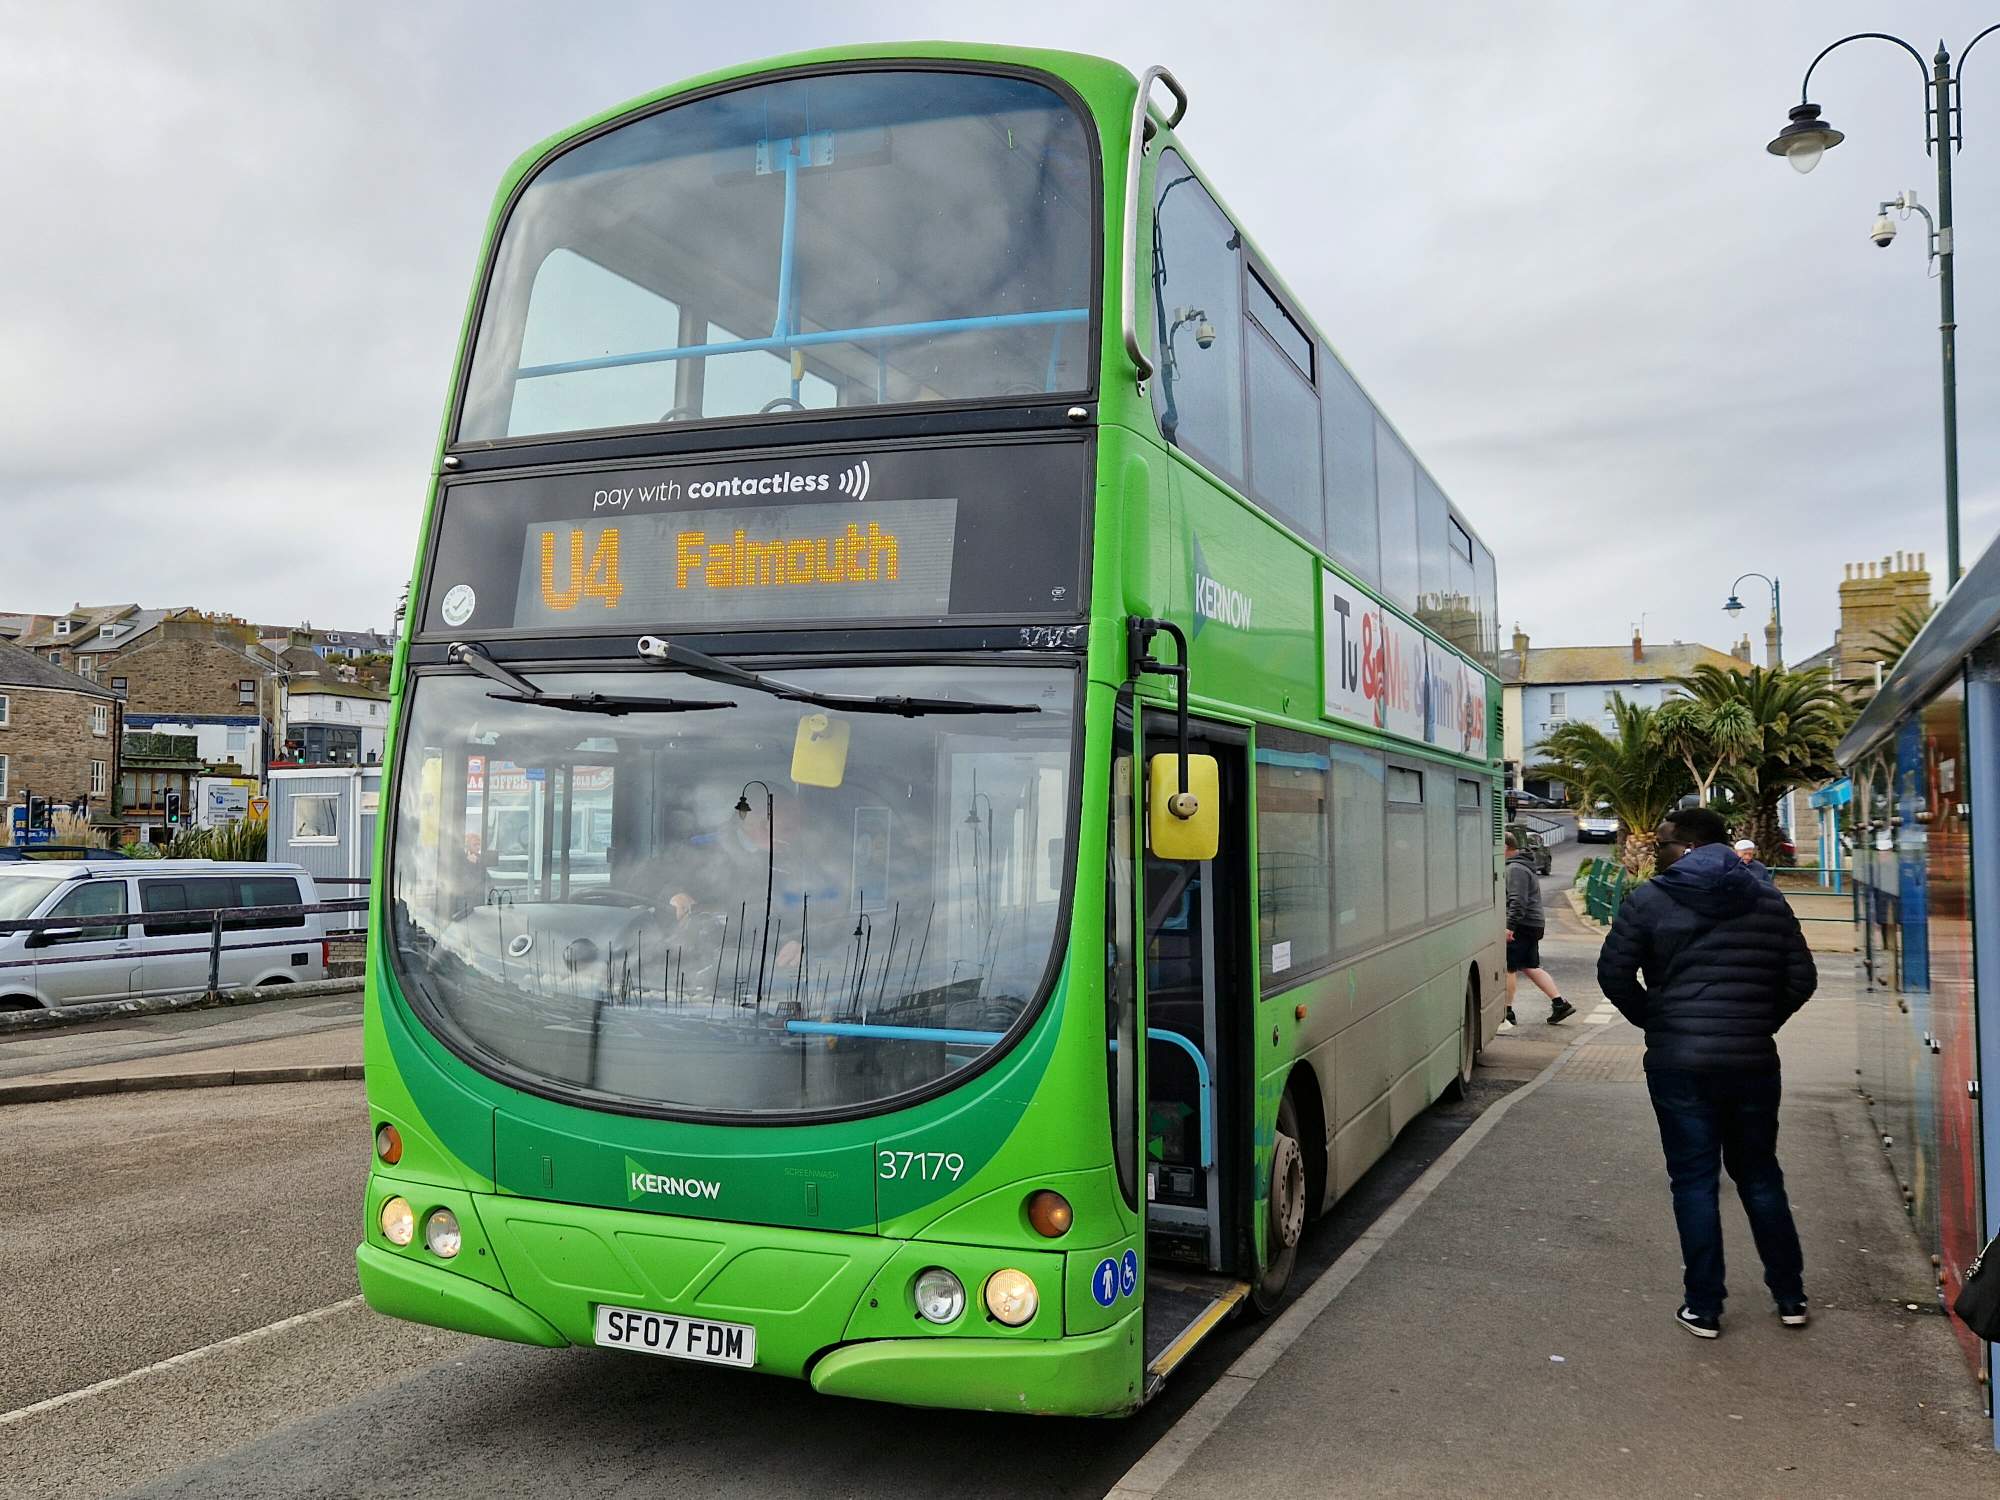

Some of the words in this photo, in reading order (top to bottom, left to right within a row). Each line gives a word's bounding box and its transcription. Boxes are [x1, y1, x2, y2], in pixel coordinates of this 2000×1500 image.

[593, 486, 633, 511] pay
[639, 480, 681, 502] with
[687, 472, 830, 499] contactless
[541, 528, 624, 610] U4
[676, 521, 897, 590] Falmouth
[1195, 573, 1252, 633] KERNOW
[1334, 594, 1358, 693] Tu
[631, 1172, 721, 1201] KERNOW
[879, 1151, 964, 1182] 37179
[608, 1311, 679, 1349] SF07
[687, 1322, 743, 1360] FDM
